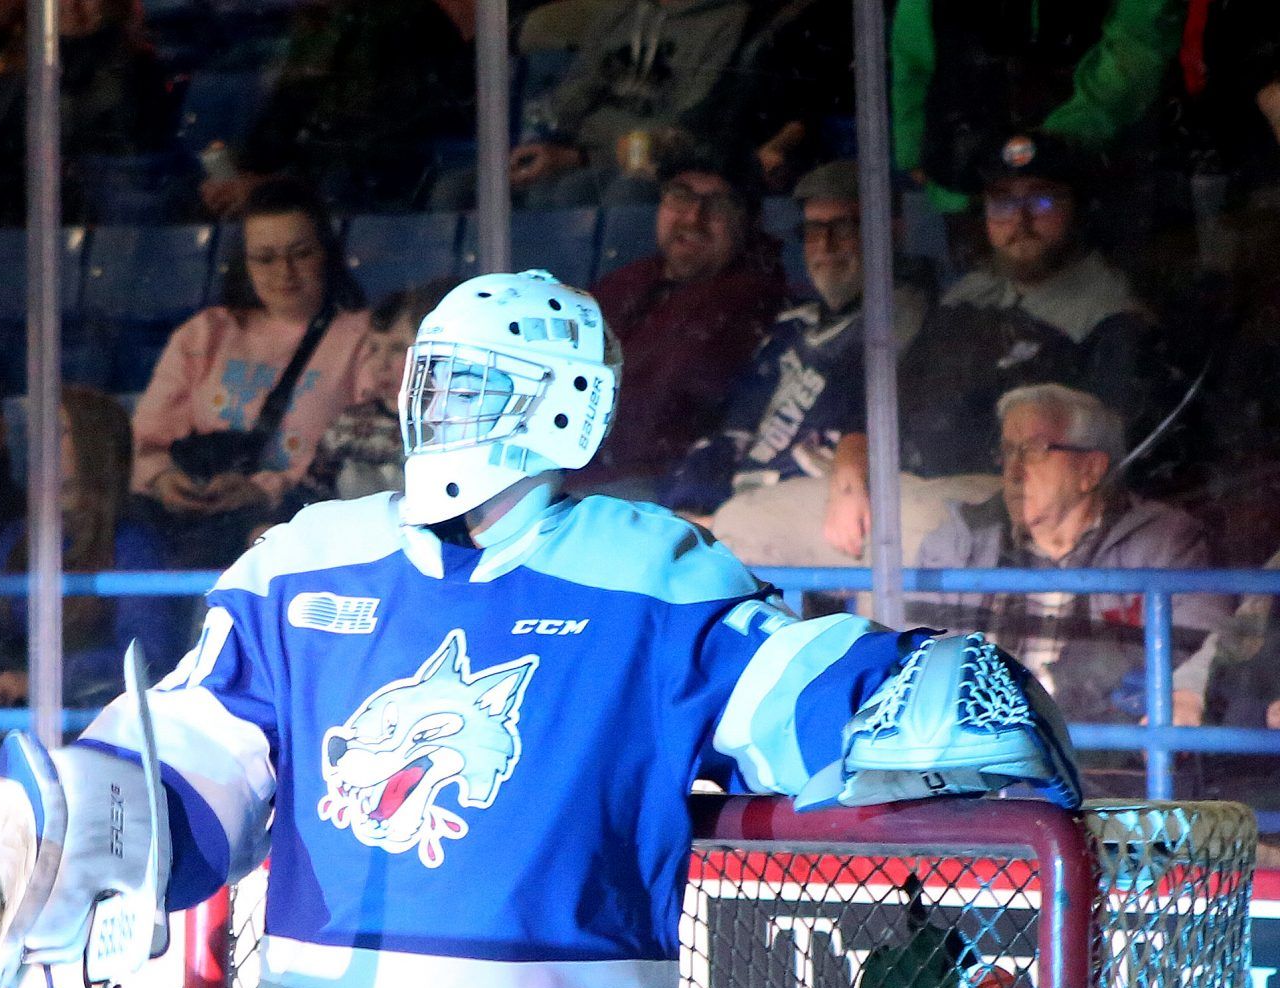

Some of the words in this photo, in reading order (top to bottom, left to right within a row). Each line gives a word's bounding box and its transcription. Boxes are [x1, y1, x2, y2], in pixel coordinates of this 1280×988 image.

[578, 375, 605, 450] BAUER
[287, 592, 380, 634] OHL
[511, 618, 590, 635] CCM
